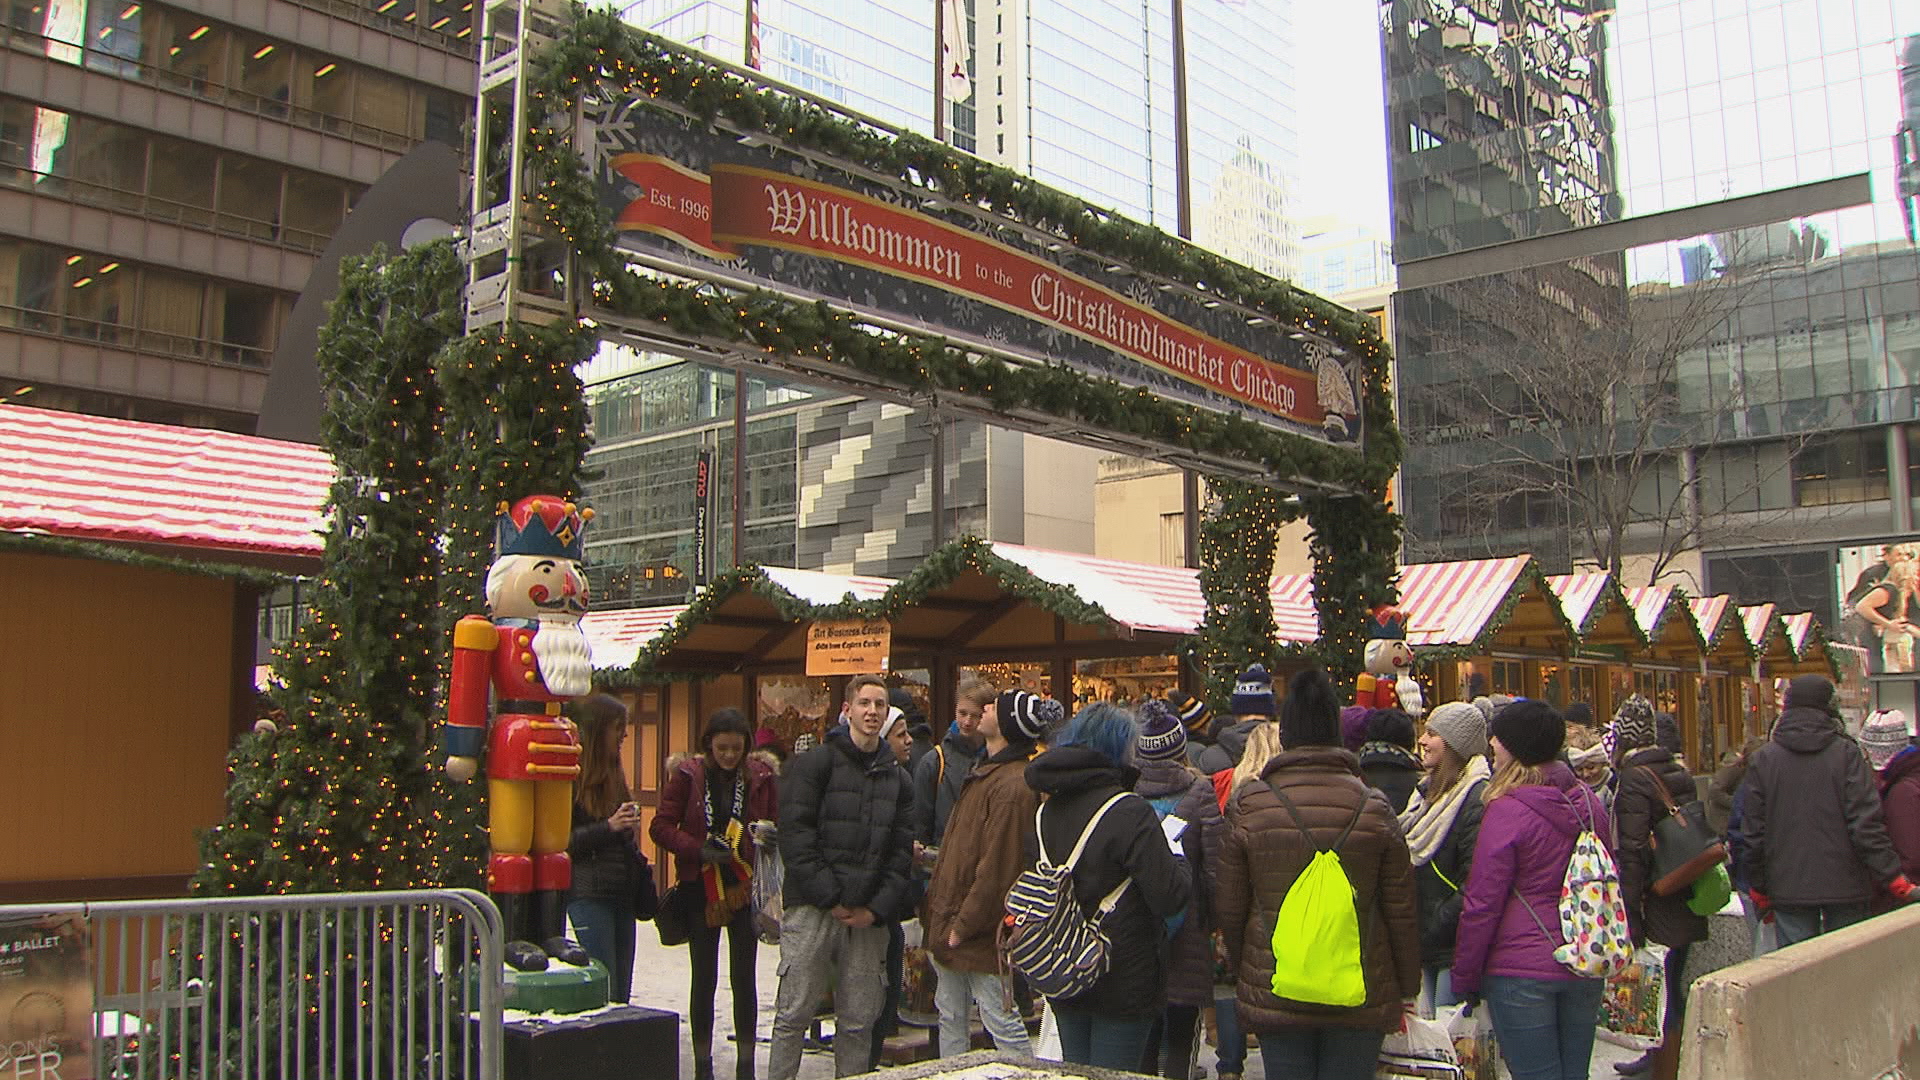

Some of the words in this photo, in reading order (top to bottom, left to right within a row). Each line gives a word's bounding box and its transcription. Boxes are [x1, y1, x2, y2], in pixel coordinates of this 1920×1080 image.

[651, 188, 676, 210] Est.
[680, 197, 710, 222] 1996
[764, 184, 961, 281] Willkommen
[975, 263, 988, 280] to
[994, 268, 1013, 289] the
[1031, 272, 1225, 385] Christkindlmarket
[1230, 359, 1295, 414] Chicago
[13, 936, 60, 952] BALLET
